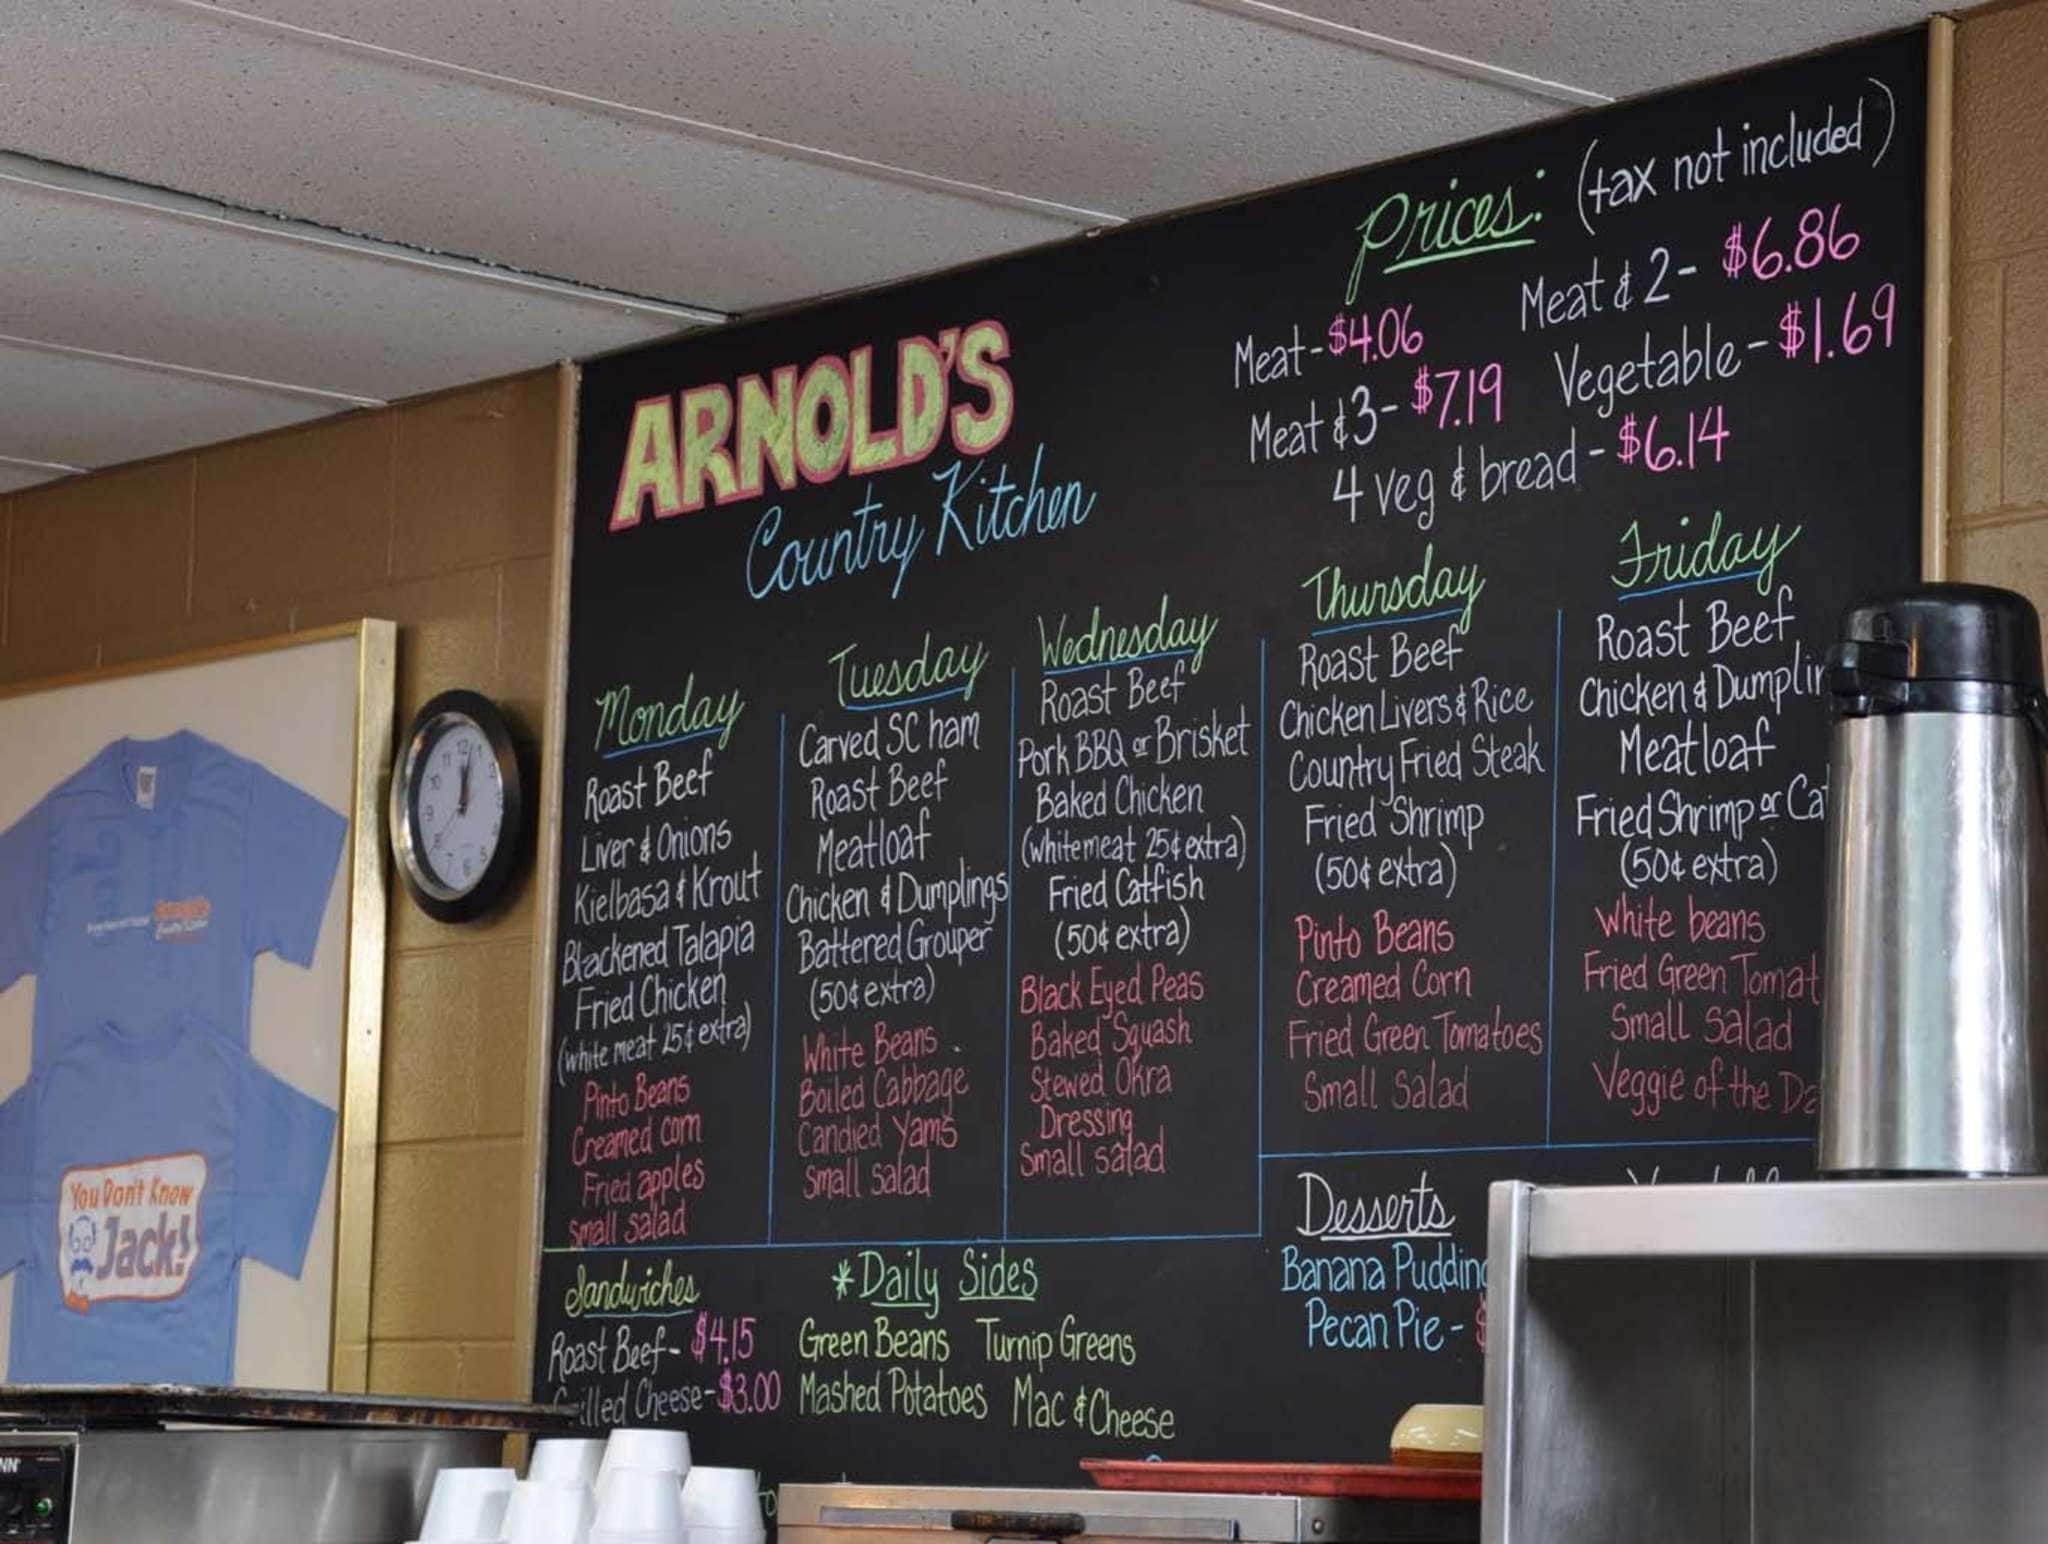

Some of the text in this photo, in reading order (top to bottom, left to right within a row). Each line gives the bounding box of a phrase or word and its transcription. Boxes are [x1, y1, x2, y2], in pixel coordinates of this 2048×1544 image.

[1578, 139, 1657, 235] (tax
[1675, 127, 1730, 191] not
[1521, 257, 1605, 331] Meat
[1723, 203, 1860, 279] $6.86
[1327, 303, 1424, 364] $4.06
[1779, 283, 1896, 363] $1.69
[609, 320, 1014, 532] ARNOLD'S
[1250, 399, 1323, 463] Meat
[1411, 362, 1502, 429] $7.19
[1332, 464, 1363, 522] 4
[1480, 426, 1577, 503] bread
[1616, 405, 1730, 472] $6.14
[746, 442, 1097, 600] Country Kitchen
[1611, 510, 1802, 596] Friday
[1301, 543, 1486, 635] Thursday
[1037, 593, 1219, 675] Wednesday
[1597, 584, 1795, 661] Roast Beef
[827, 630, 990, 708] Tuesday
[1298, 623, 1464, 691] Roast Beef
[595, 672, 746, 750] Monday
[1041, 659, 1186, 726] Roast Beef
[1280, 693, 1376, 740] Chicken
[1580, 672, 1688, 718] Chicken
[800, 715, 881, 768] Carved
[928, 707, 980, 750] ham
[1018, 703, 1251, 779] Pork BBQ or Brisket
[1289, 724, 1546, 806] Country Fried Steak
[584, 748, 714, 823] Roast Beef
[810, 758, 949, 822] Roast Beef
[1036, 772, 1204, 823] Baked Chicken
[1576, 788, 1784, 841] Fried Shrimp or
[581, 816, 732, 873] Liver Onions
[1305, 794, 1485, 850] Fried Shrimp
[574, 850, 762, 925] Kielbasa Krout
[786, 856, 1009, 925] Chicken Dumplings
[1050, 862, 1205, 912] Fried Catfish
[1378, 842, 1456, 898] extra)
[1692, 837, 1779, 886] extra)
[562, 916, 755, 987] Blackened Talapia
[798, 917, 992, 975] Battered Grouper
[1116, 904, 1190, 955] extra)
[1295, 909, 1455, 963] Pinto Beans
[576, 969, 727, 1031] Fried Chicken
[864, 963, 935, 1007] extra)
[1021, 960, 1205, 1020] Black Eyed Peas
[1296, 958, 1472, 1007] Creamed Corn
[1584, 949, 1648, 993] Fried
[1658, 951, 1727, 995] Green
[614, 1024, 657, 1065] meat
[803, 1020, 938, 1074] White Beans
[1031, 1007, 1193, 1062] Baked Squash
[1289, 1004, 1543, 1060] Fried Green Tomatoes
[583, 1072, 691, 1122] Pinto Beans
[799, 1063, 969, 1119] Boiled Cabbage
[1030, 1056, 1172, 1103] Stewed Okra
[1593, 1049, 1770, 1117] Veggie of the
[799, 1111, 882, 1158] Candied
[1040, 1104, 1133, 1145] Dressing
[71, 1176, 195, 1211] You Don't Know
[582, 1170, 631, 1207] Fried
[1297, 1171, 1456, 1237] Desserts
[95, 1211, 191, 1281] Jack!
[1281, 1245, 1386, 1292] Banana
[564, 1258, 700, 1318] Sandwiches
[959, 1247, 1038, 1299] Sides
[548, 1325, 607, 1382] Roast
[690, 1310, 757, 1365] $4.15
[800, 1314, 1136, 1372] Green Beans Turnip Greens
[1305, 1297, 1389, 1349] Pecan
[1393, 1298, 1445, 1351] Pie
[717, 1368, 782, 1414] $3.00
[800, 1366, 1065, 1429] Mashed Potatoes Mac
